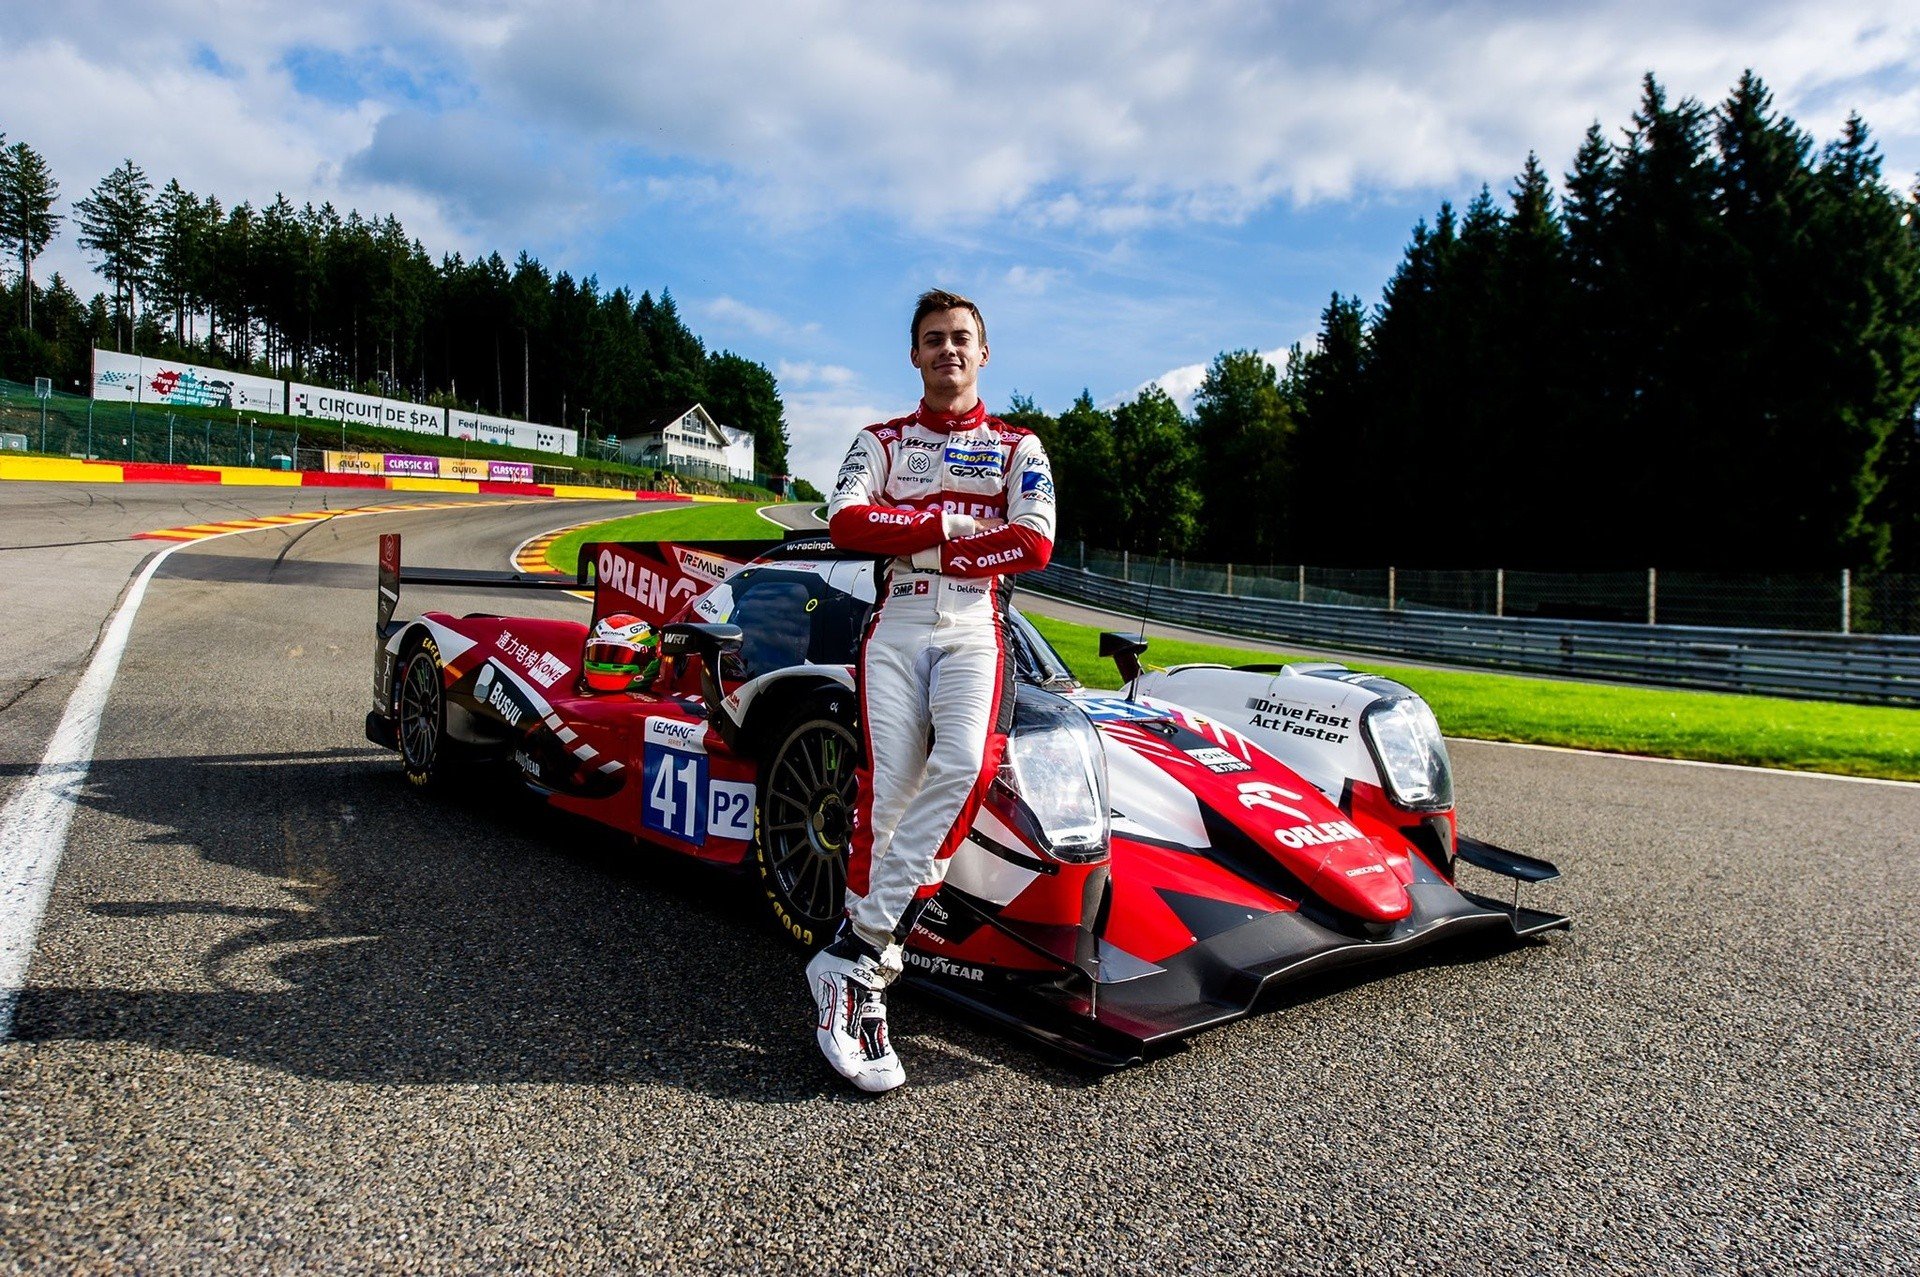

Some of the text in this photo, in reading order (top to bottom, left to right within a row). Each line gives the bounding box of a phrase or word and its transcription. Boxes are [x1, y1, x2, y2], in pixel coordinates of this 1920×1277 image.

[157, 377, 173, 385] Two
[319, 397, 381, 419] CIRCUIT
[386, 408, 406, 423] DE
[410, 410, 438, 429] SPA
[480, 421, 515, 436] inspired
[905, 439, 946, 449] WRT
[389, 459, 433, 471] CLASSIC 21
[520, 467, 529, 476] 21
[949, 464, 988, 479] GPX
[920, 476, 934, 484] grou
[868, 511, 914, 526] ORLEN
[684, 553, 727, 580] REMUS
[976, 546, 1024, 568] ORLEN
[598, 548, 669, 614] ORLEN
[893, 584, 914, 596] OMP
[948, 582, 956, 591] L.
[495, 629, 540, 669] 通力电梯
[664, 632, 690, 645] WRT
[422, 637, 444, 669] EAGLE
[535, 658, 563, 682] KONE
[489, 681, 523, 727] BUSUU
[1256, 699, 1352, 729] Drive Fast
[1249, 714, 1349, 744] Act Faster
[650, 753, 698, 838] 41
[712, 790, 750, 829] P2
[1274, 820, 1366, 850] ORLEN
[901, 950, 985, 982] OODYEAR
